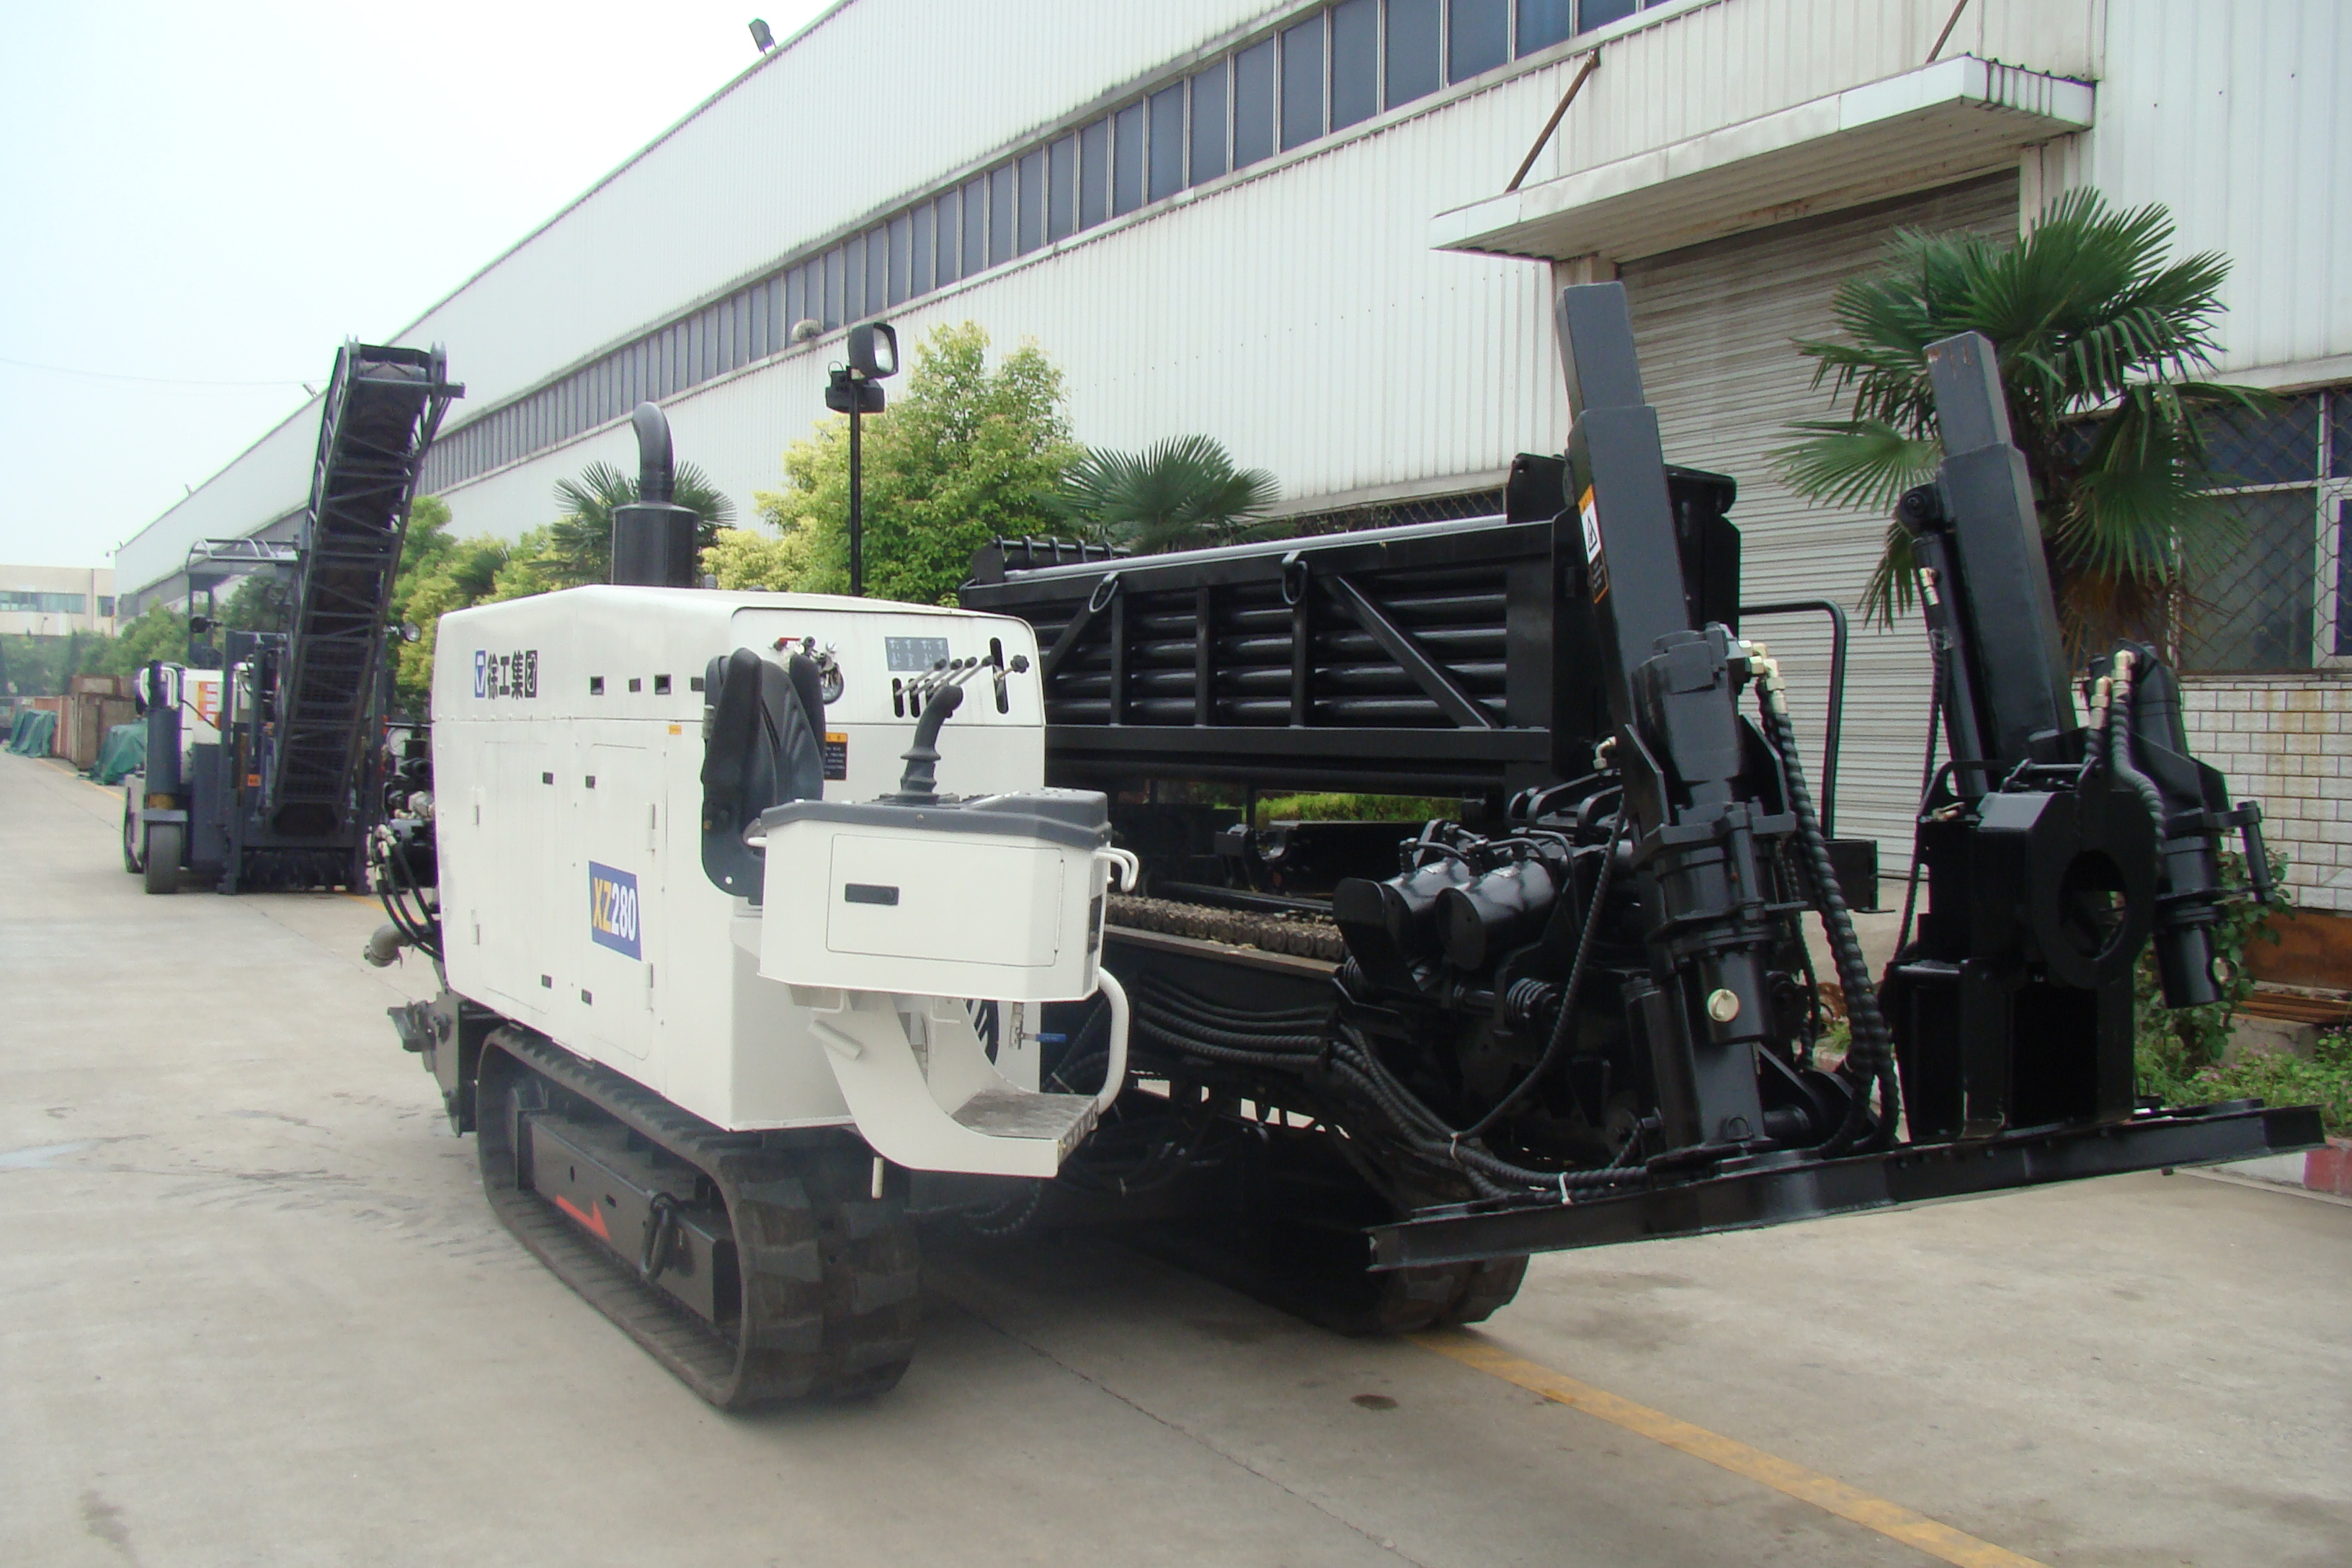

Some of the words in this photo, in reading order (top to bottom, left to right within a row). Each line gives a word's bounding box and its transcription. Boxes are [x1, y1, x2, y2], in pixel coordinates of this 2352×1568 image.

[488, 650, 538, 700] 徐工集团
[593, 877, 637, 942] XZ280
